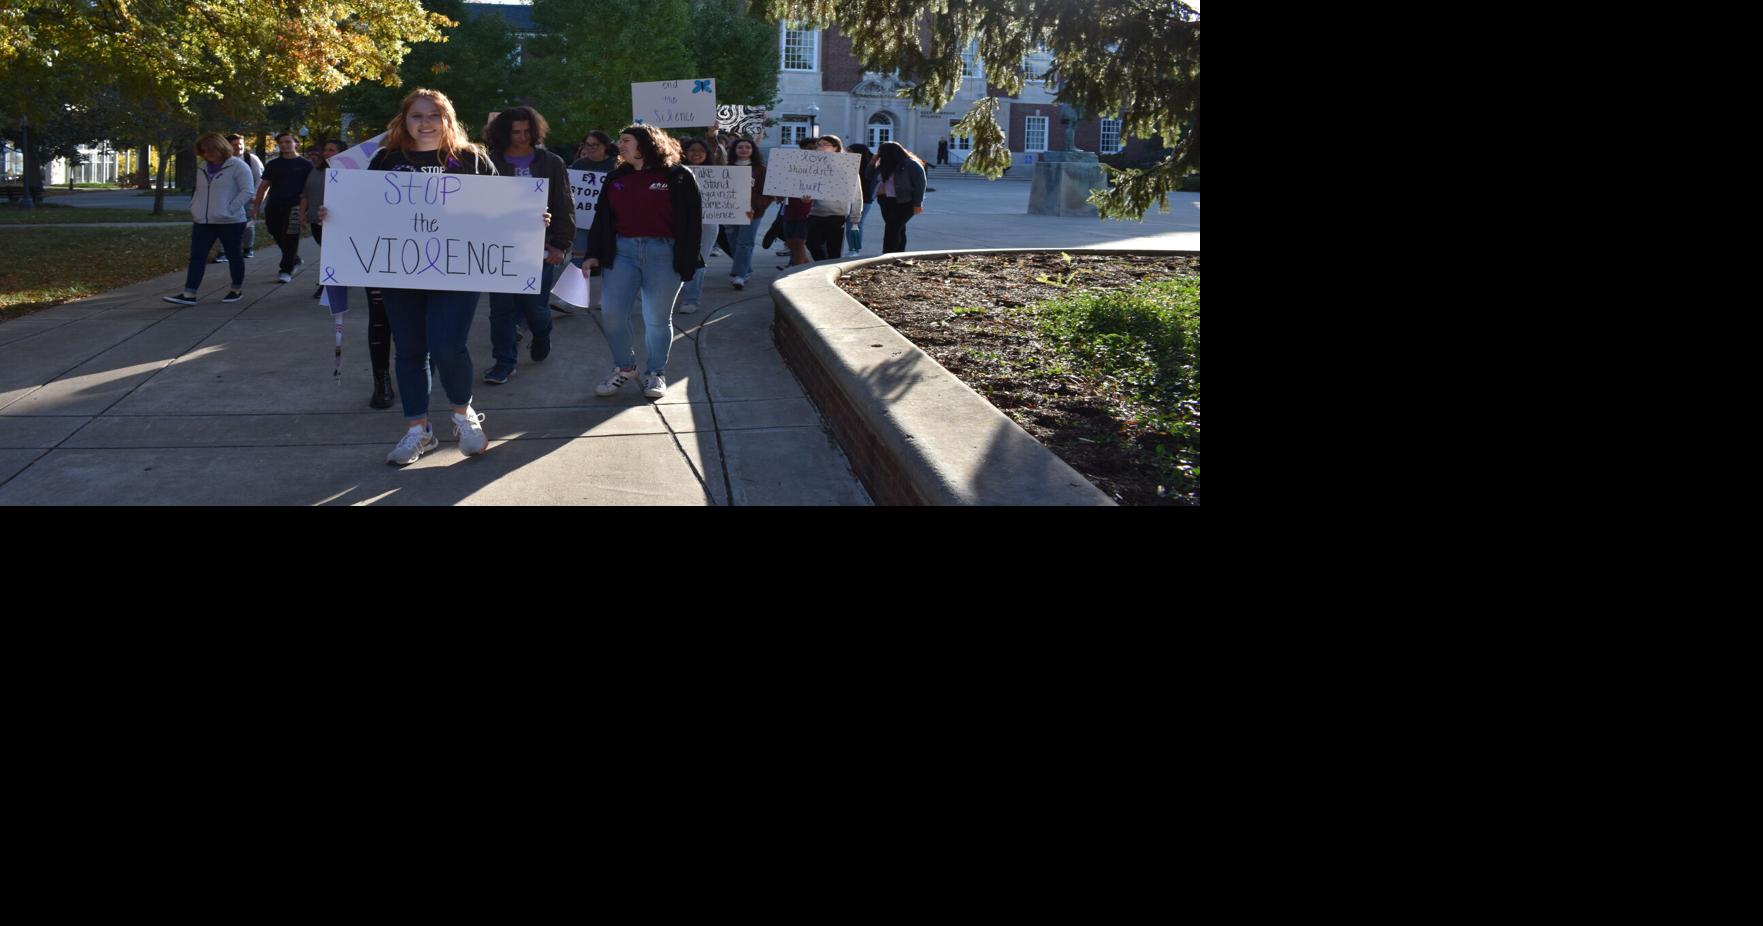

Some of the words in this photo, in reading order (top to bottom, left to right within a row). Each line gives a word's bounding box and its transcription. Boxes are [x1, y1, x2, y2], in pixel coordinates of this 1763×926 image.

[662, 80, 679, 89] end
[421, 166, 446, 174] STOP
[800, 180, 826, 193] hurt
[409, 213, 439, 232] the
[349, 236, 518, 277] VIOLENCE
